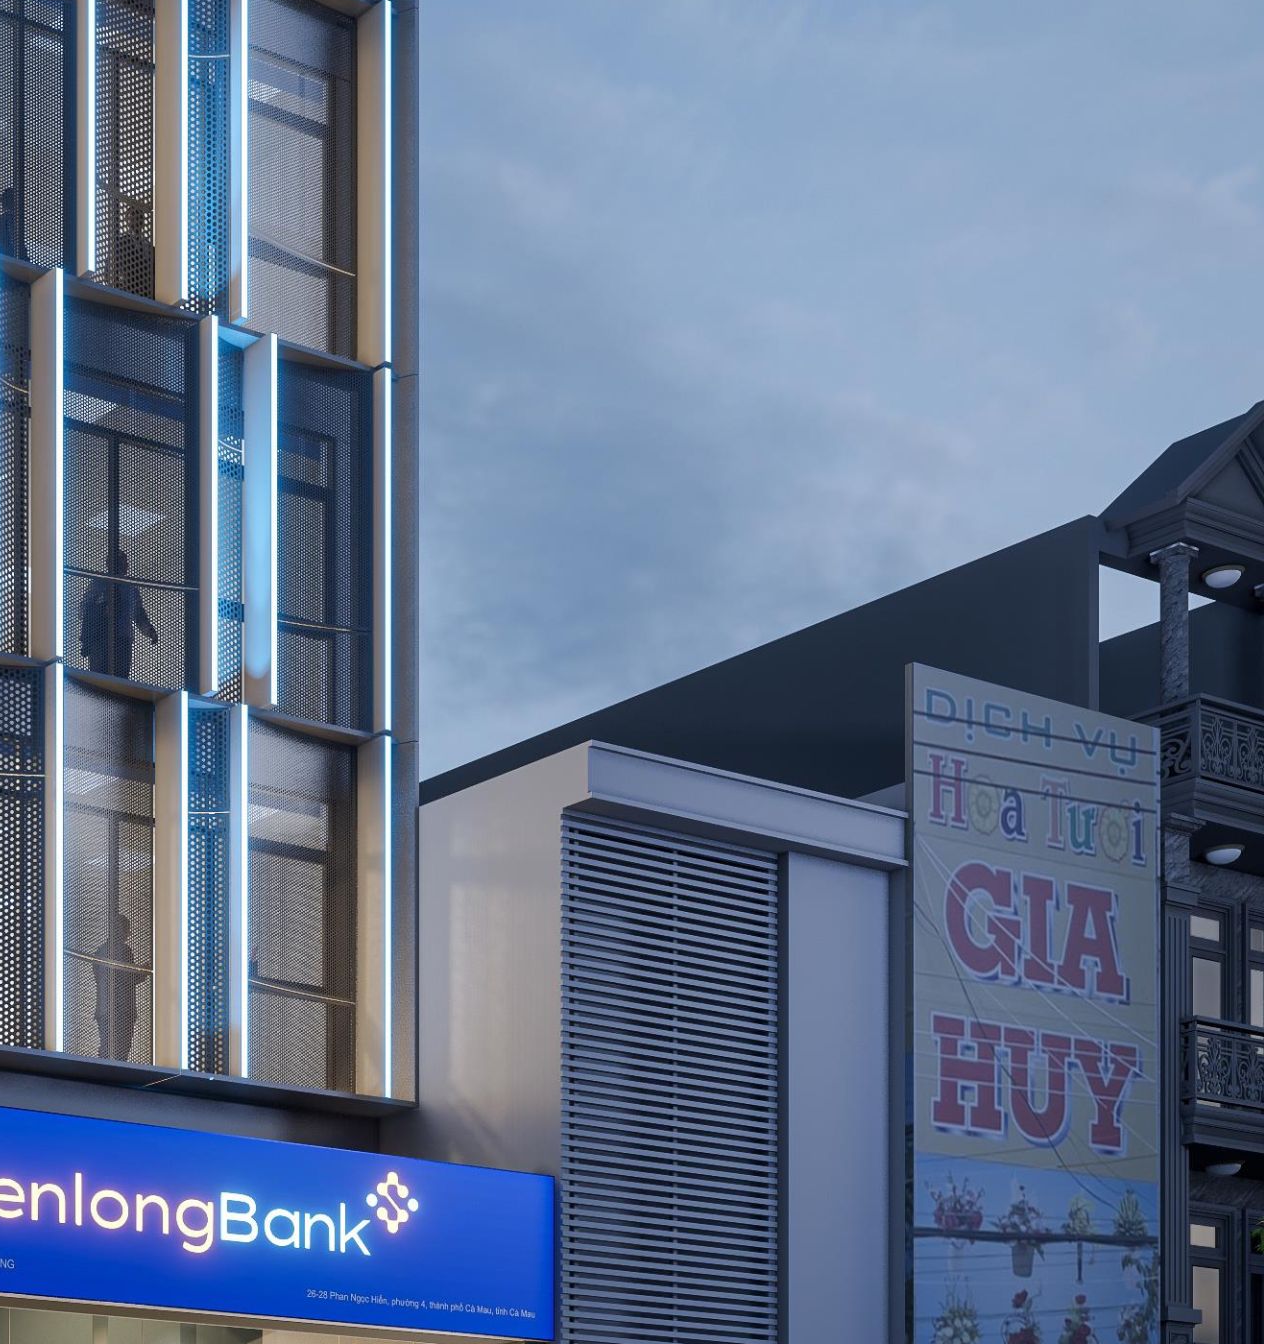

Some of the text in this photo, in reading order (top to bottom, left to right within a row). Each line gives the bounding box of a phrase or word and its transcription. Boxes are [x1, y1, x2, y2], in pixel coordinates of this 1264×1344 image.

[924, 687, 1138, 776] DỊCH VỤ
[944, 860, 1130, 1005] GIA
[931, 1011, 1143, 1156] HUY
[306, 1288, 328, 1300] 26-28
[329, 1291, 349, 1301] Phan
[520, 1309, 536, 1319] Mau
